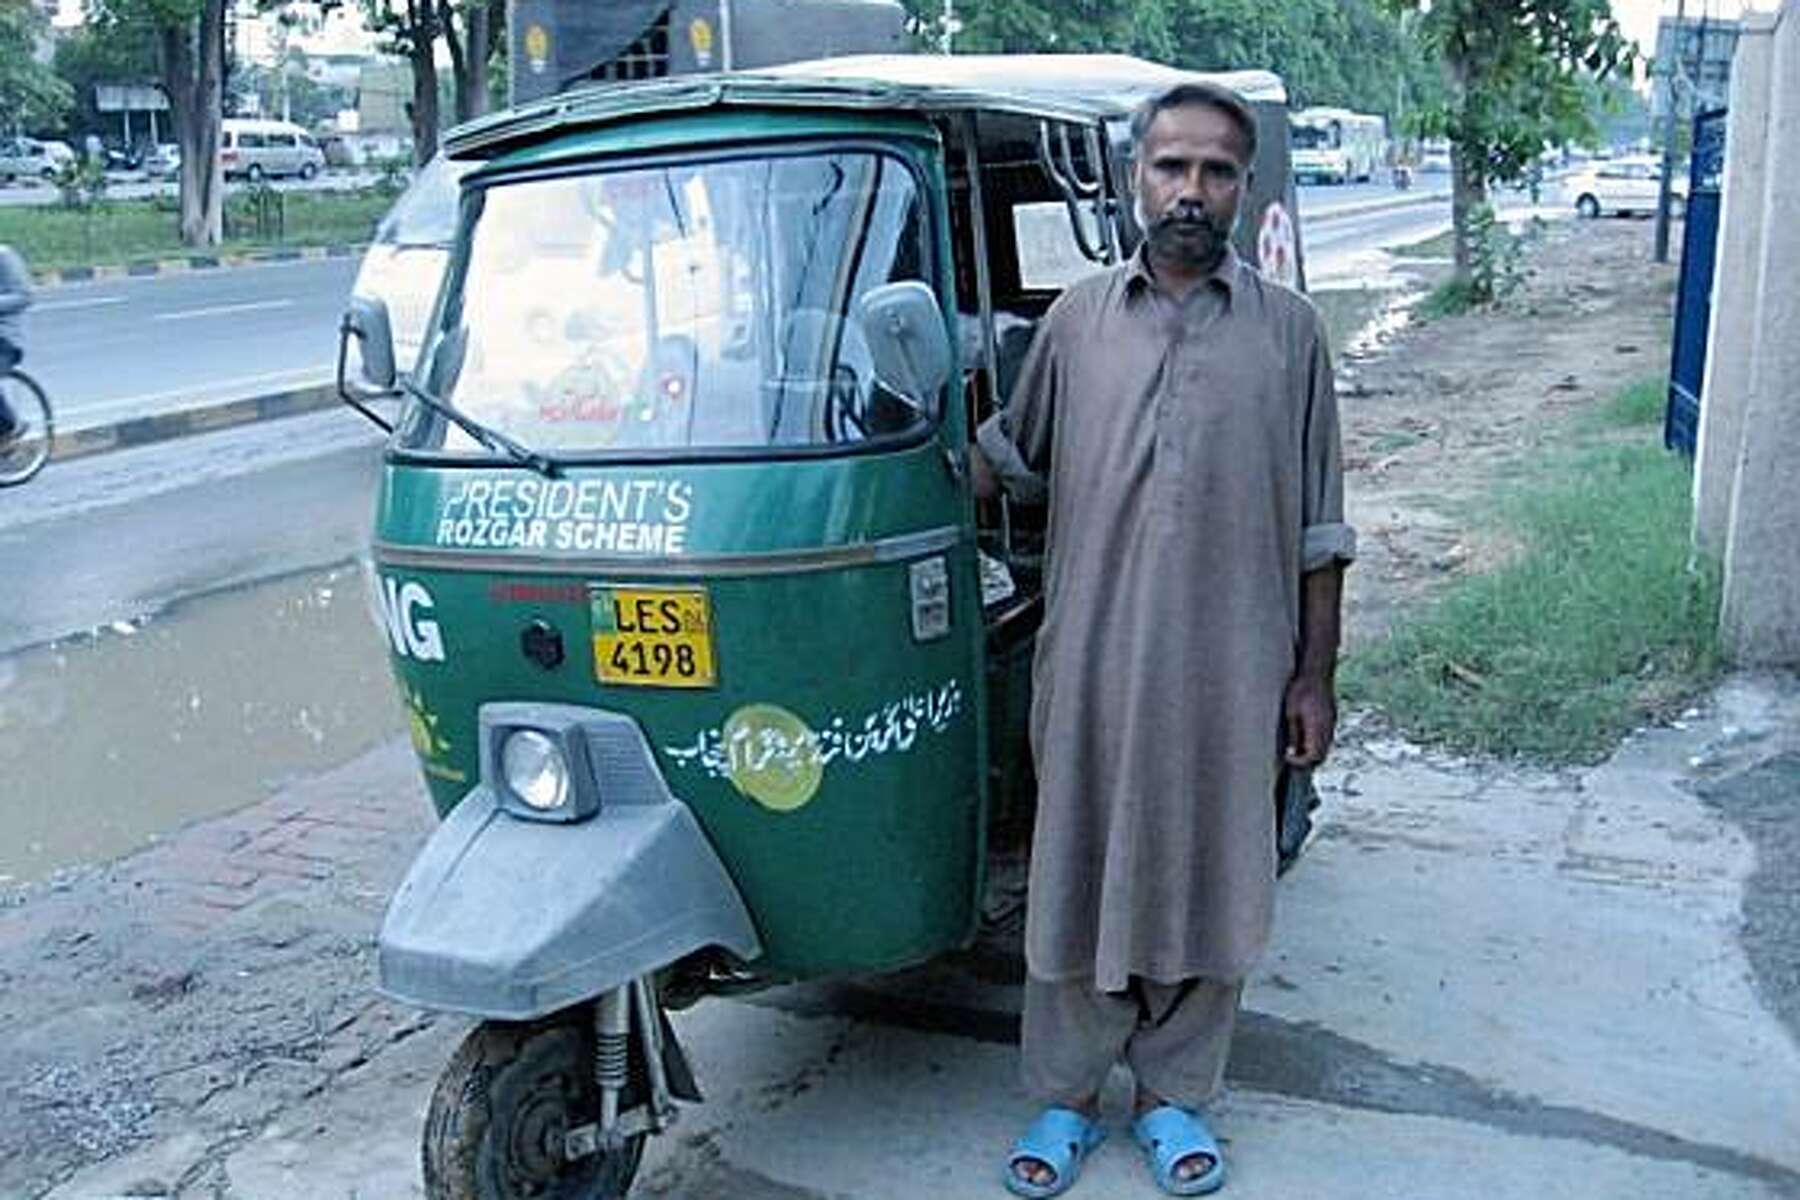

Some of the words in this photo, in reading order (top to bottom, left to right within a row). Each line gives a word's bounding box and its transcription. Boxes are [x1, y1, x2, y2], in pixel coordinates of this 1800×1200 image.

[441, 479, 692, 523] PRESIDENT'S
[436, 518, 546, 548] ROZGAR
[555, 521, 688, 554] SCHEME
[612, 599, 681, 634] LES
[611, 640, 696, 677] 4198
